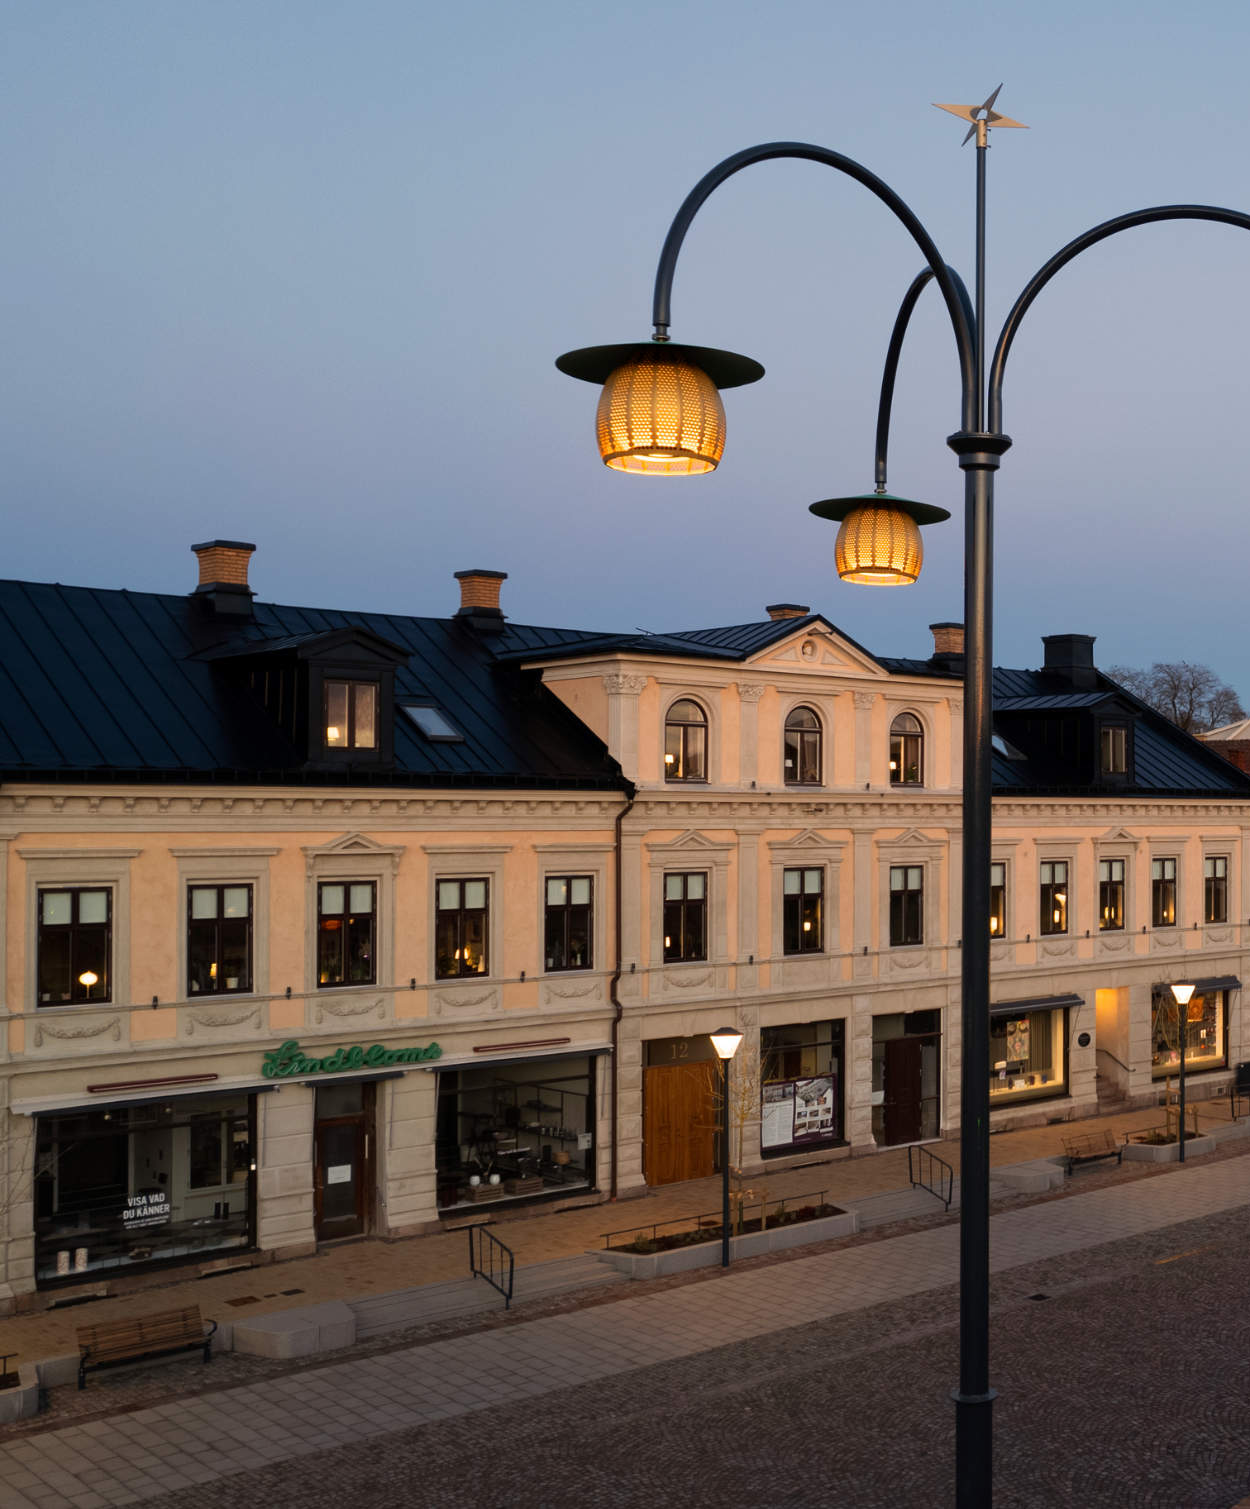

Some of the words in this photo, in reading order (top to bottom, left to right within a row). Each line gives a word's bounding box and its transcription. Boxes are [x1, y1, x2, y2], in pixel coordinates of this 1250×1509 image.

[672, 1041, 688, 1059] 12
[262, 1040, 442, 1078] Lindbloms
[128, 1195, 147, 1207] VISA
[149, 1193, 165, 1204] VAD
[123, 1208, 135, 1220] DU
[136, 1203, 170, 1218] KÄNNER
